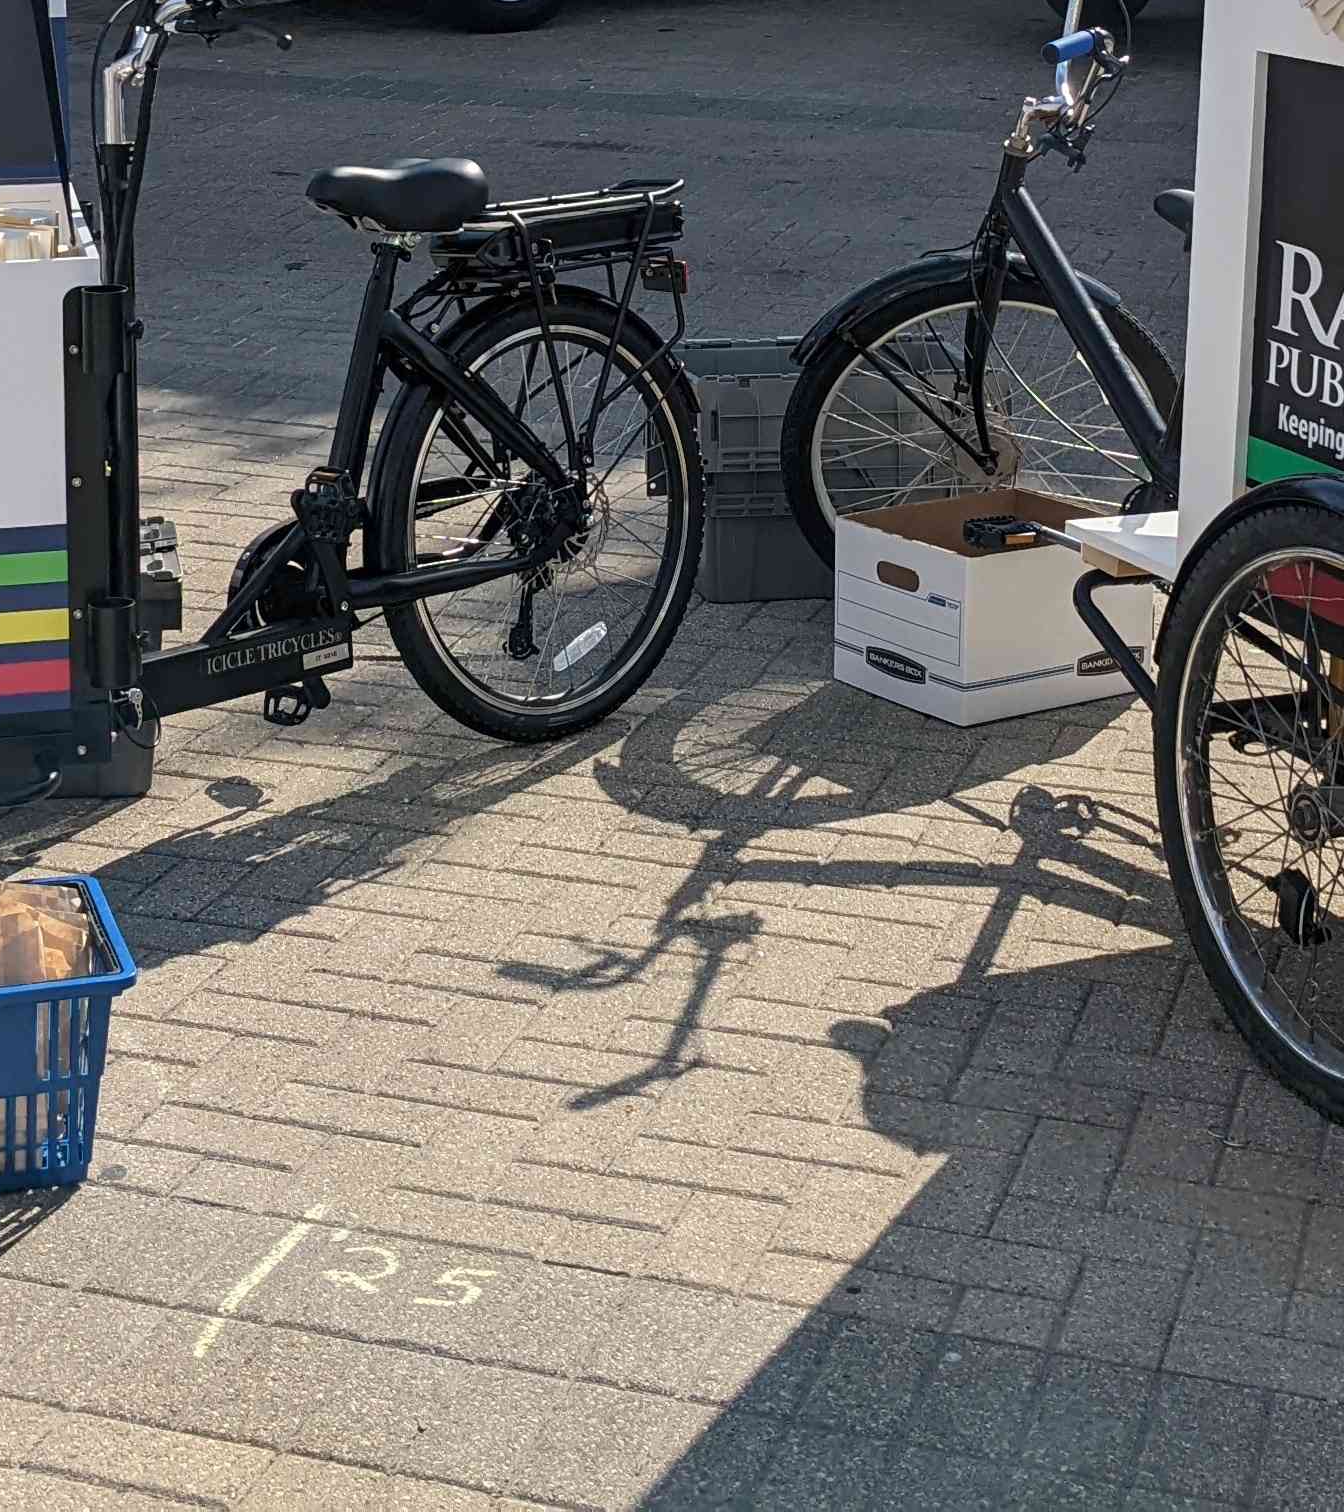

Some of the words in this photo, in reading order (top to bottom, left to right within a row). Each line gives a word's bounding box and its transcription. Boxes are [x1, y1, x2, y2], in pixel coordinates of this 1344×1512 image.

[208, 650, 255, 676] ICICLE
[257, 628, 336, 661] TRICYCLES
[869, 652, 905, 672] BANKERS
[905, 665, 923, 679] BOX
